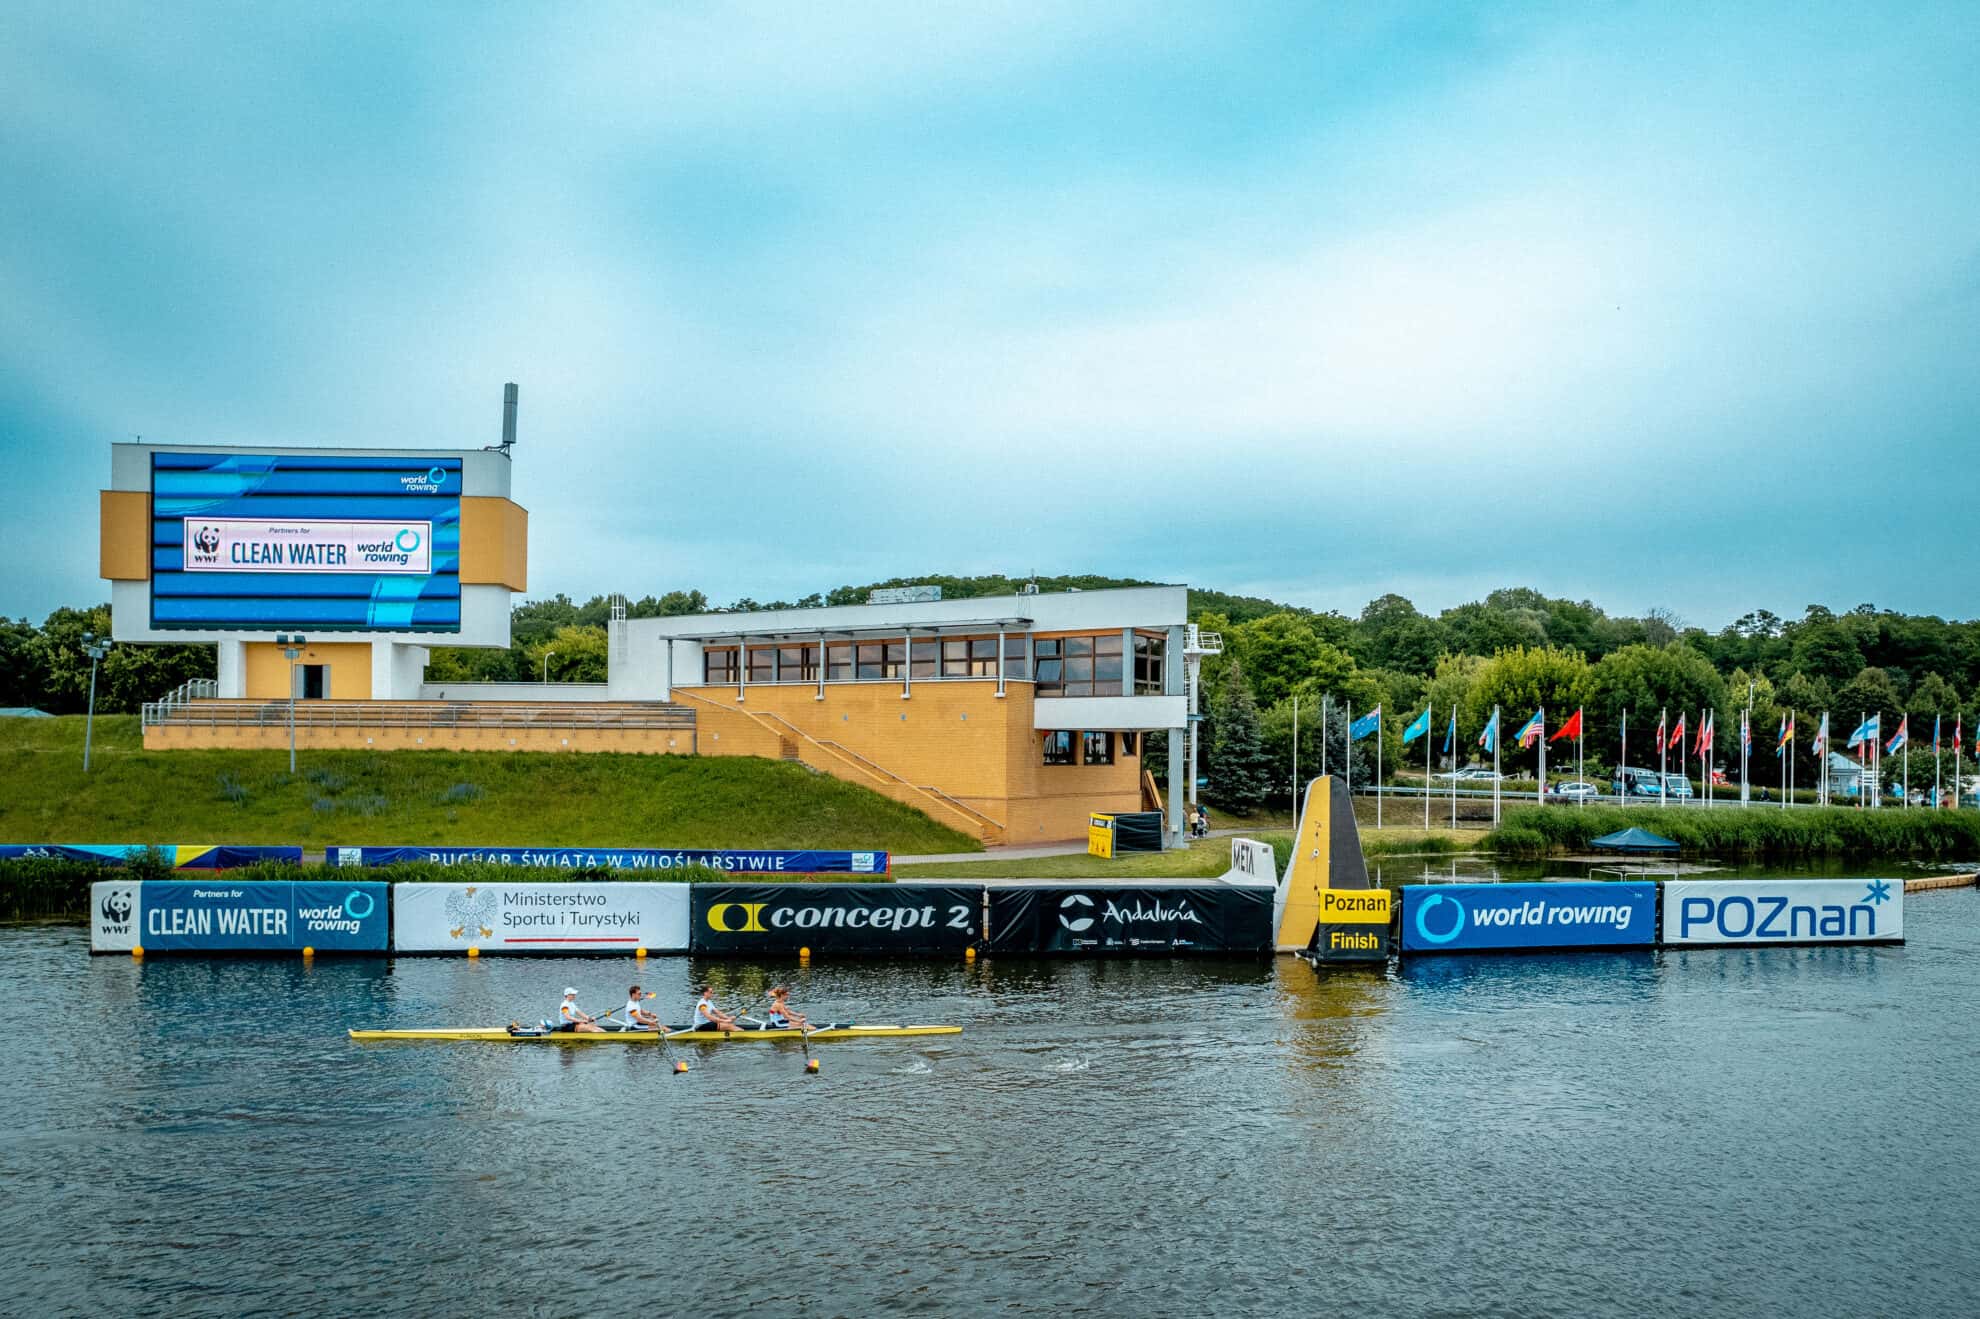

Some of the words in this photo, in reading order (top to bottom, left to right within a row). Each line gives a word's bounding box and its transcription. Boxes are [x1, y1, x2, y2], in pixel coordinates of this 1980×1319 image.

[400, 475, 427, 484] world
[406, 484, 438, 493] rowing
[268, 527, 299, 535] Partners
[300, 527, 310, 535] for
[231, 542, 283, 565] CLEAN
[288, 543, 347, 566] WATER
[357, 541, 393, 553] world
[194, 555, 219, 564] WWF
[364, 553, 409, 566] rowing
[520, 851, 598, 868] ŚWIATA
[606, 855, 623, 868] W
[1233, 842, 1255, 876] META
[193, 889, 228, 899] Partners
[231, 889, 243, 899] for
[503, 892, 607, 906] Ministerstwo
[1324, 894, 1387, 911] Poznan
[299, 904, 343, 920] world
[503, 911, 556, 929] Sportu
[560, 911, 565, 926] i
[571, 911, 640, 929] Turystyki
[770, 905, 937, 931] concept
[946, 905, 970, 928] 2
[1102, 899, 1202, 924] Andalucía
[1472, 901, 1546, 927] world
[1547, 905, 1633, 930] rowing
[101, 925, 131, 935] WWF
[148, 908, 211, 936] CLEAN
[217, 908, 288, 936] WATER
[308, 917, 361, 935] rowing
[1330, 932, 1378, 949] Finish
